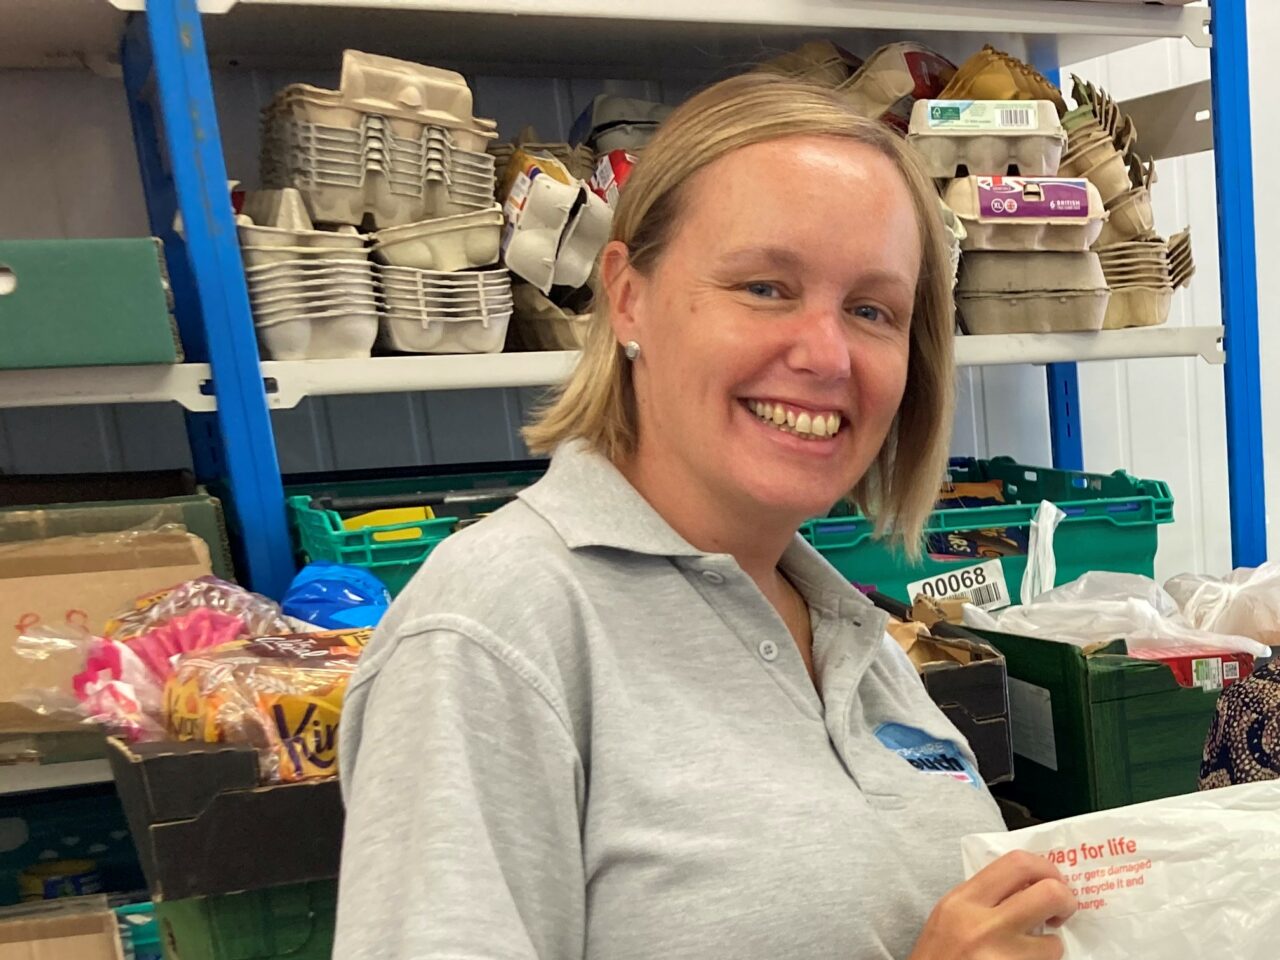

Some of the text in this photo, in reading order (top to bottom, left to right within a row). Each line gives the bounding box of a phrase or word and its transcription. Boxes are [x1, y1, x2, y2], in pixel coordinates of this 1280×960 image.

[922, 566, 986, 598] 00068
[1080, 843, 1105, 860] for
[1107, 837, 1137, 856] life
[1108, 859, 1152, 875] damaged
[1081, 880, 1115, 899] recycle
[1117, 877, 1123, 889] it
[1126, 875, 1144, 887] and
[1078, 899, 1108, 911] harge.
